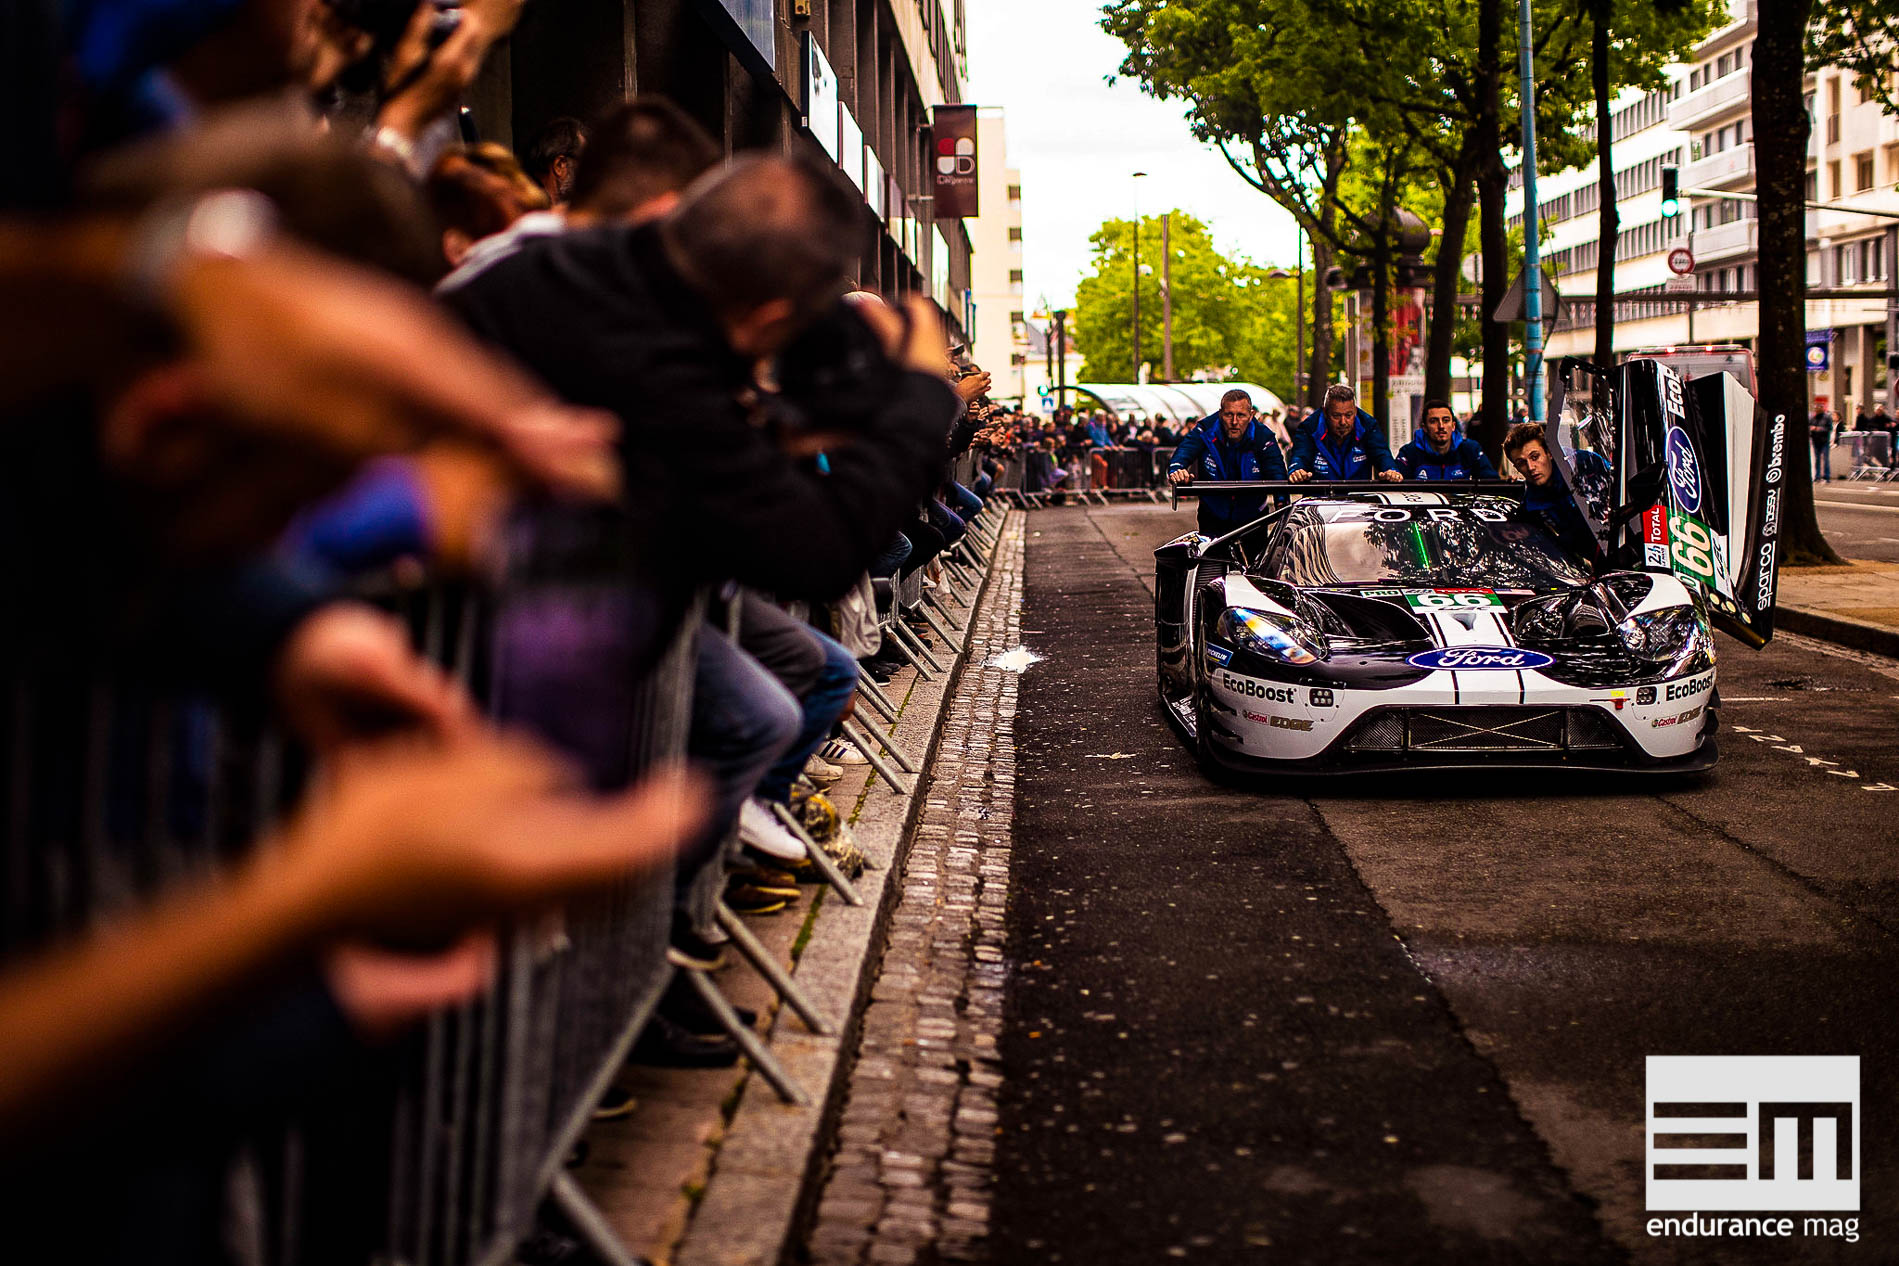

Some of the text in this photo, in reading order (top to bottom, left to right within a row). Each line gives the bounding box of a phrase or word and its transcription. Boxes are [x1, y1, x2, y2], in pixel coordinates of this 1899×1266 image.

[1767, 414, 1785, 469] brembo
[1671, 440, 1698, 499] Ford
[1329, 509, 1508, 523] FORD
[1651, 507, 1661, 542] TOTAL
[1669, 516, 1714, 577] 66
[1758, 542, 1773, 611] sparco
[1417, 593, 1492, 607] 66
[1438, 648, 1525, 667] Ford
[1223, 673, 1297, 704] EcoBoost
[1247, 712, 1268, 724] Castrol
